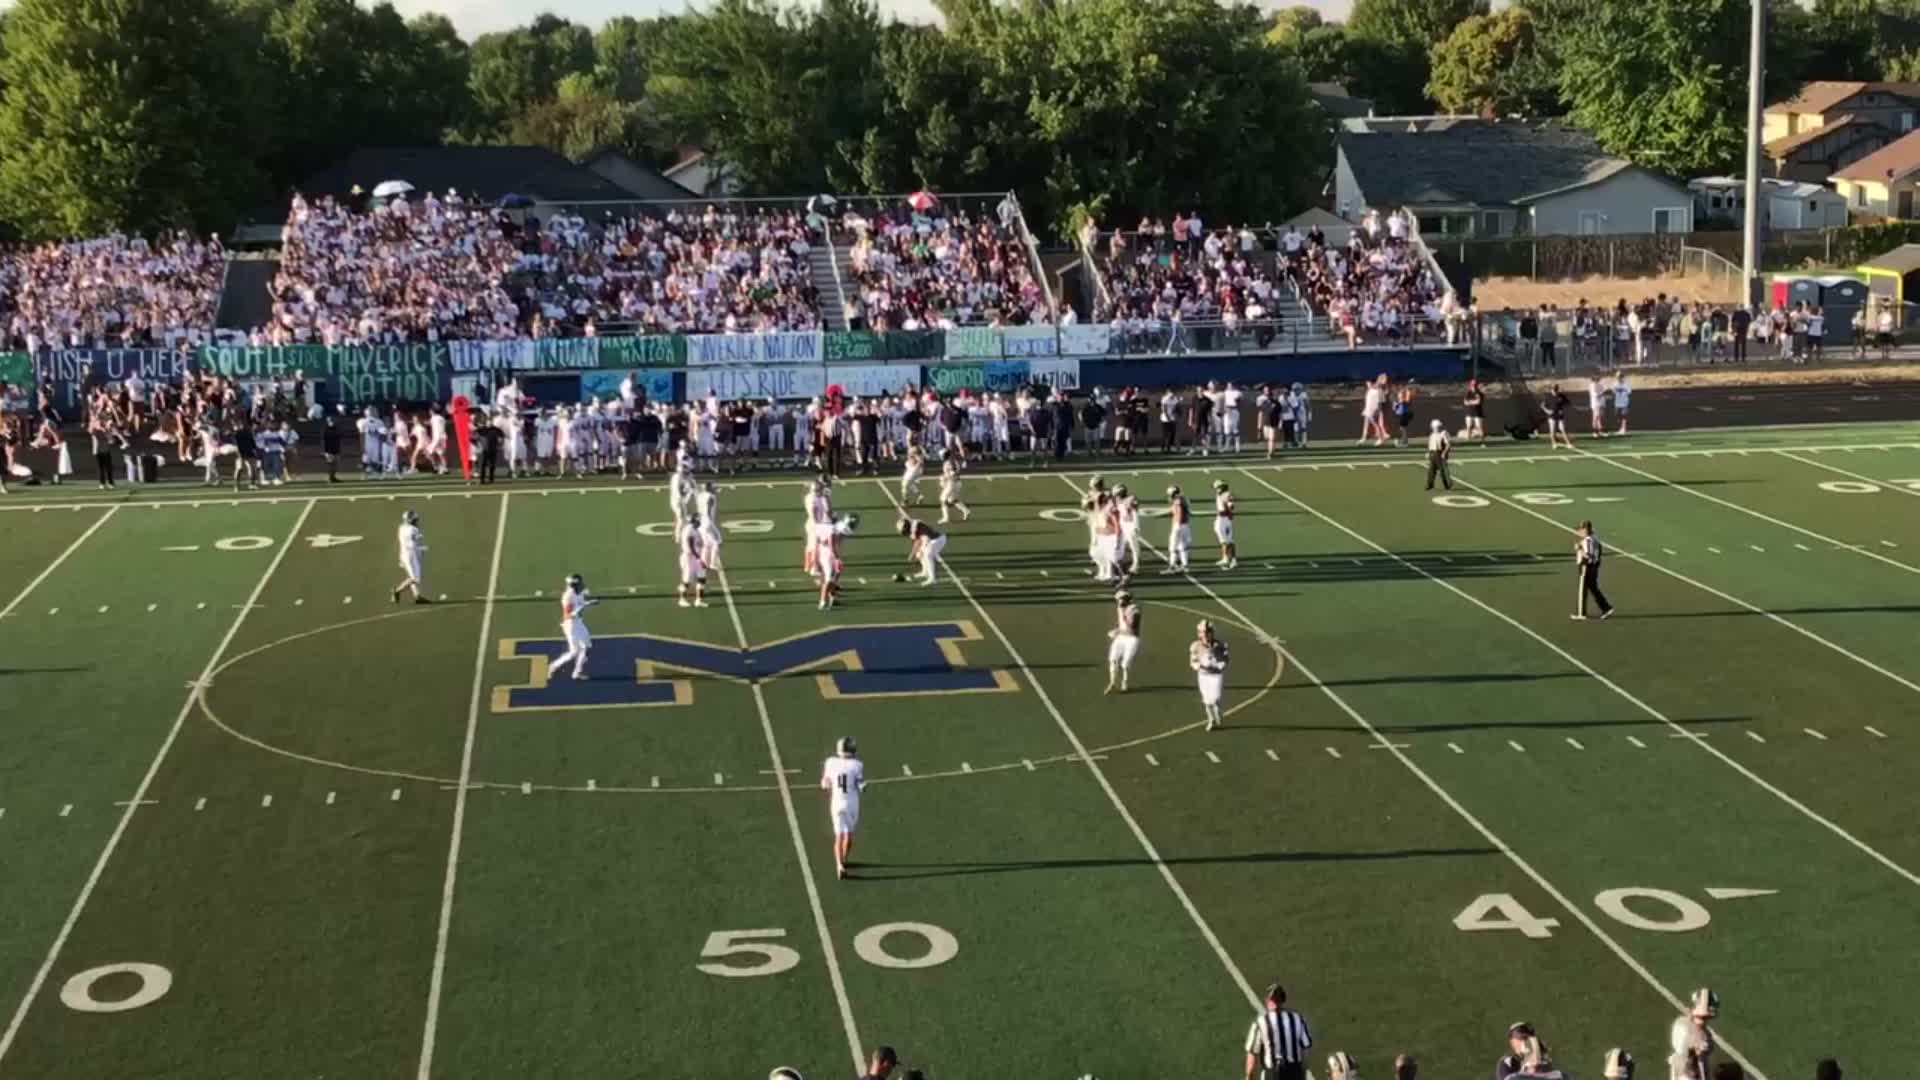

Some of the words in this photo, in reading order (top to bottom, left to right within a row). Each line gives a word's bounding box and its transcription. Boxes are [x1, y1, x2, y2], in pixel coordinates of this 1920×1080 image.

[107, 351, 125, 379] U
[201, 345, 287, 375] SOUTH
[326, 343, 446, 374] MAVERICK
[340, 374, 440, 401] NATION
[758, 370, 799, 398] RIDE
[490, 620, 1019, 712] M
[838, 773, 848, 794] 4
[1453, 886, 1712, 938] 40
[695, 921, 959, 977] 50
